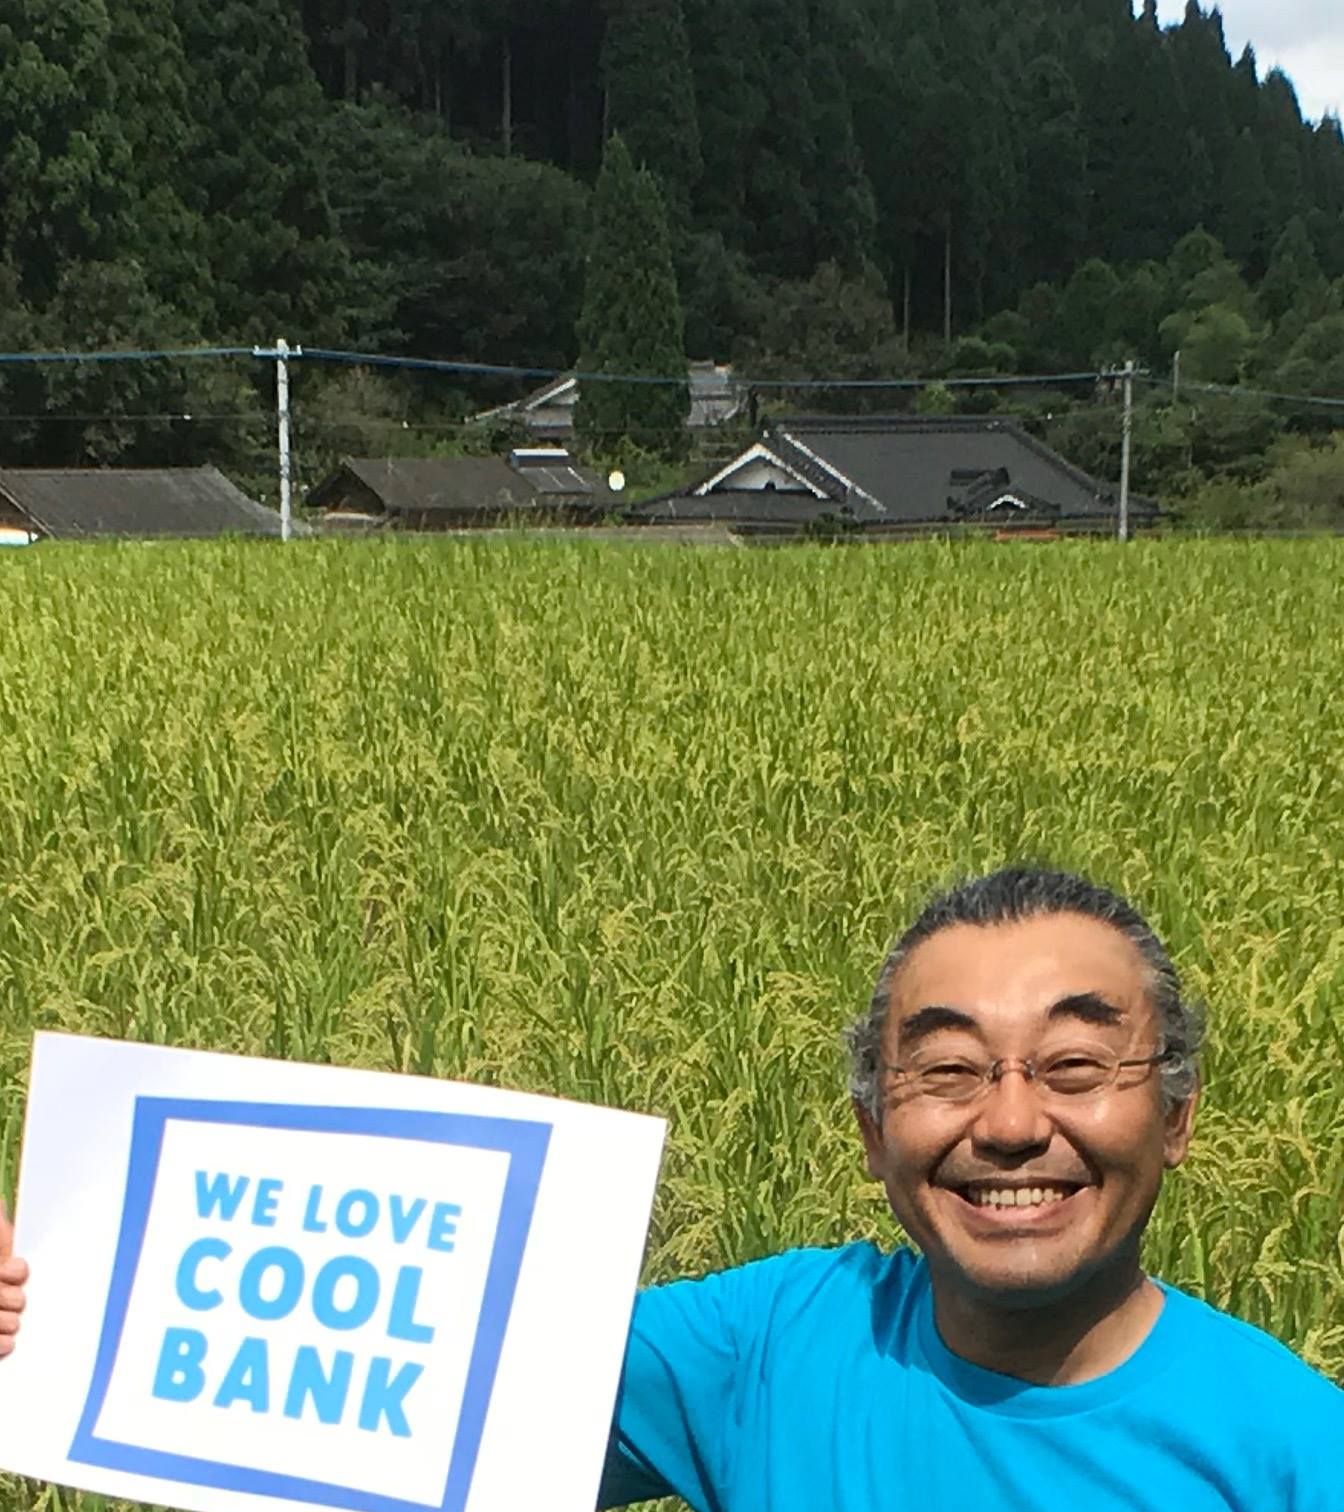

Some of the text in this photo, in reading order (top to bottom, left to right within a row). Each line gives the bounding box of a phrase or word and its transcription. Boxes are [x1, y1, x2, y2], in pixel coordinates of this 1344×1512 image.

[194, 1170, 462, 1253] WE LOVE
[175, 1238, 436, 1344] COOL
[151, 1326, 426, 1439] BANK
